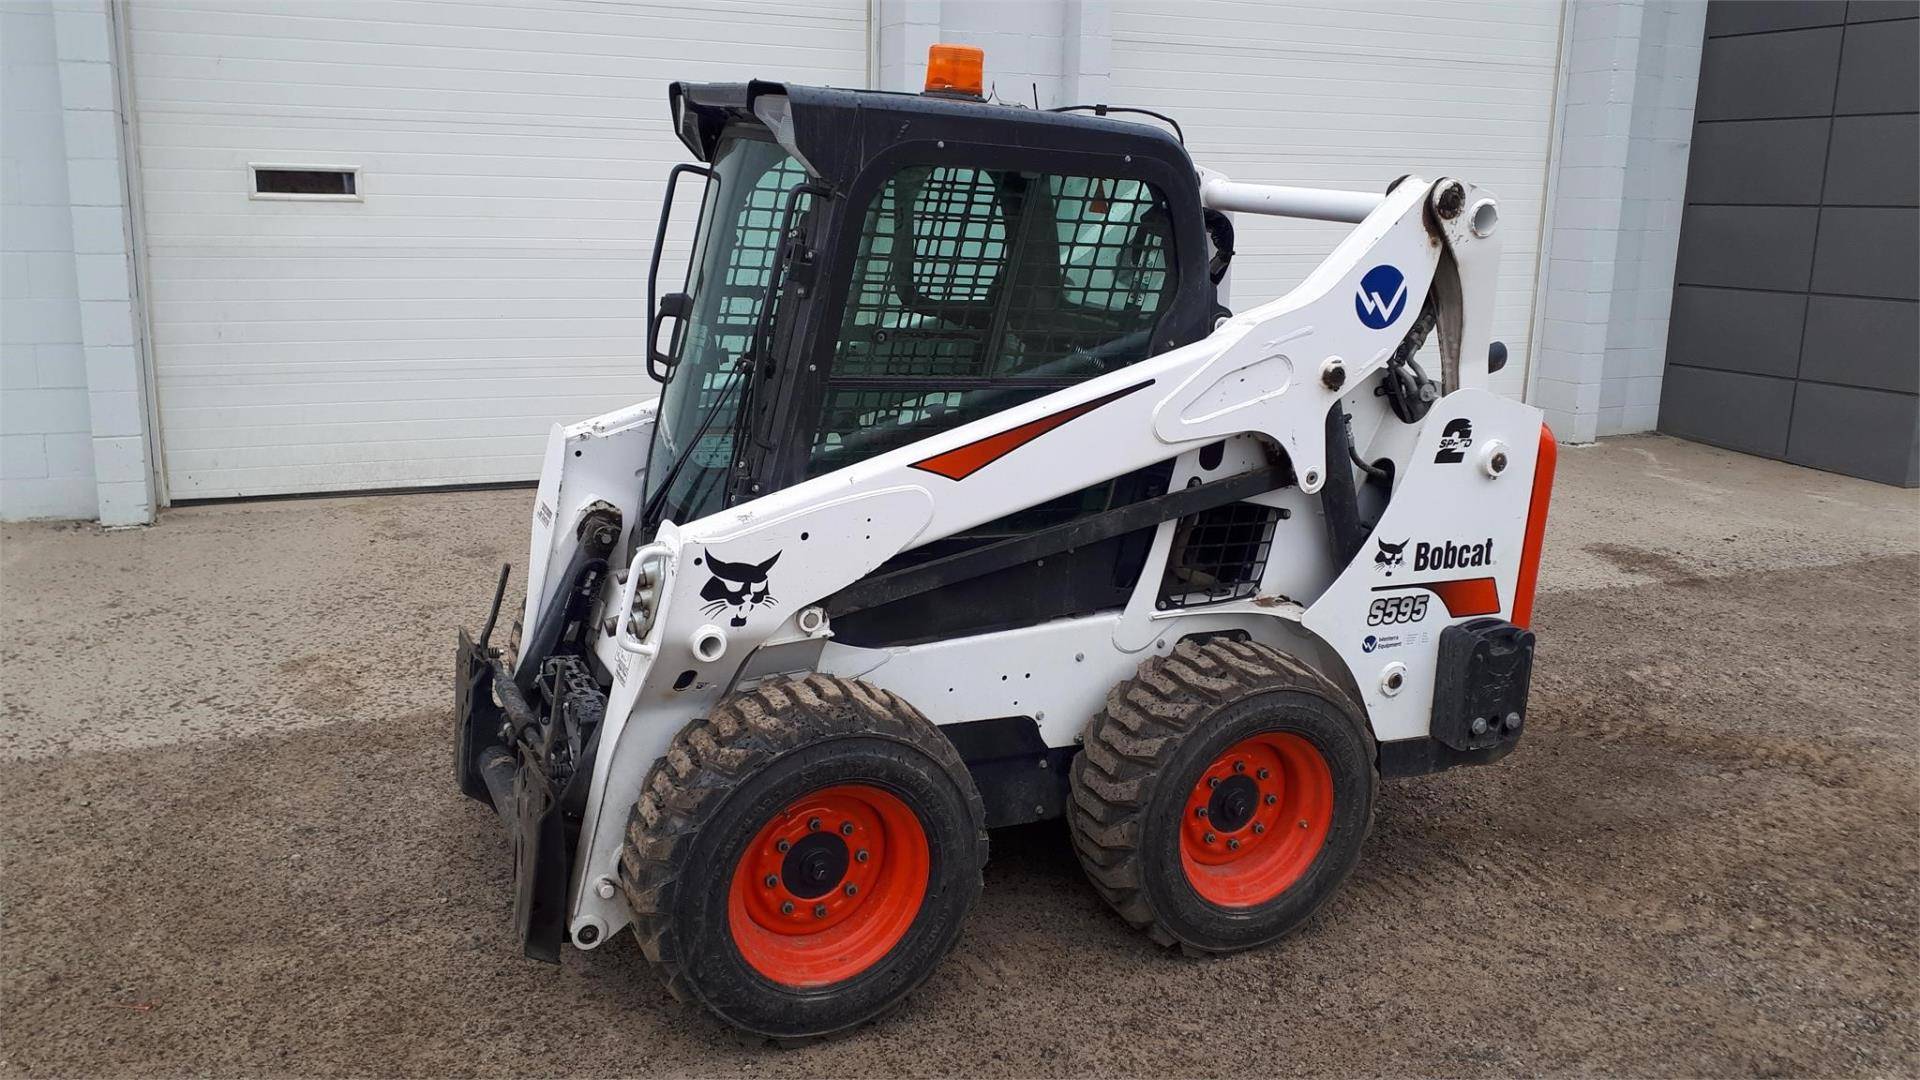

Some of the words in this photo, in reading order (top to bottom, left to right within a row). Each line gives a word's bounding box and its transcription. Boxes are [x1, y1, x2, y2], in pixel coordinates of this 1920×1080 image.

[1434, 418, 1472, 464] 2
[1414, 538, 1494, 572] Bobcat
[1367, 594, 1430, 626] S595
